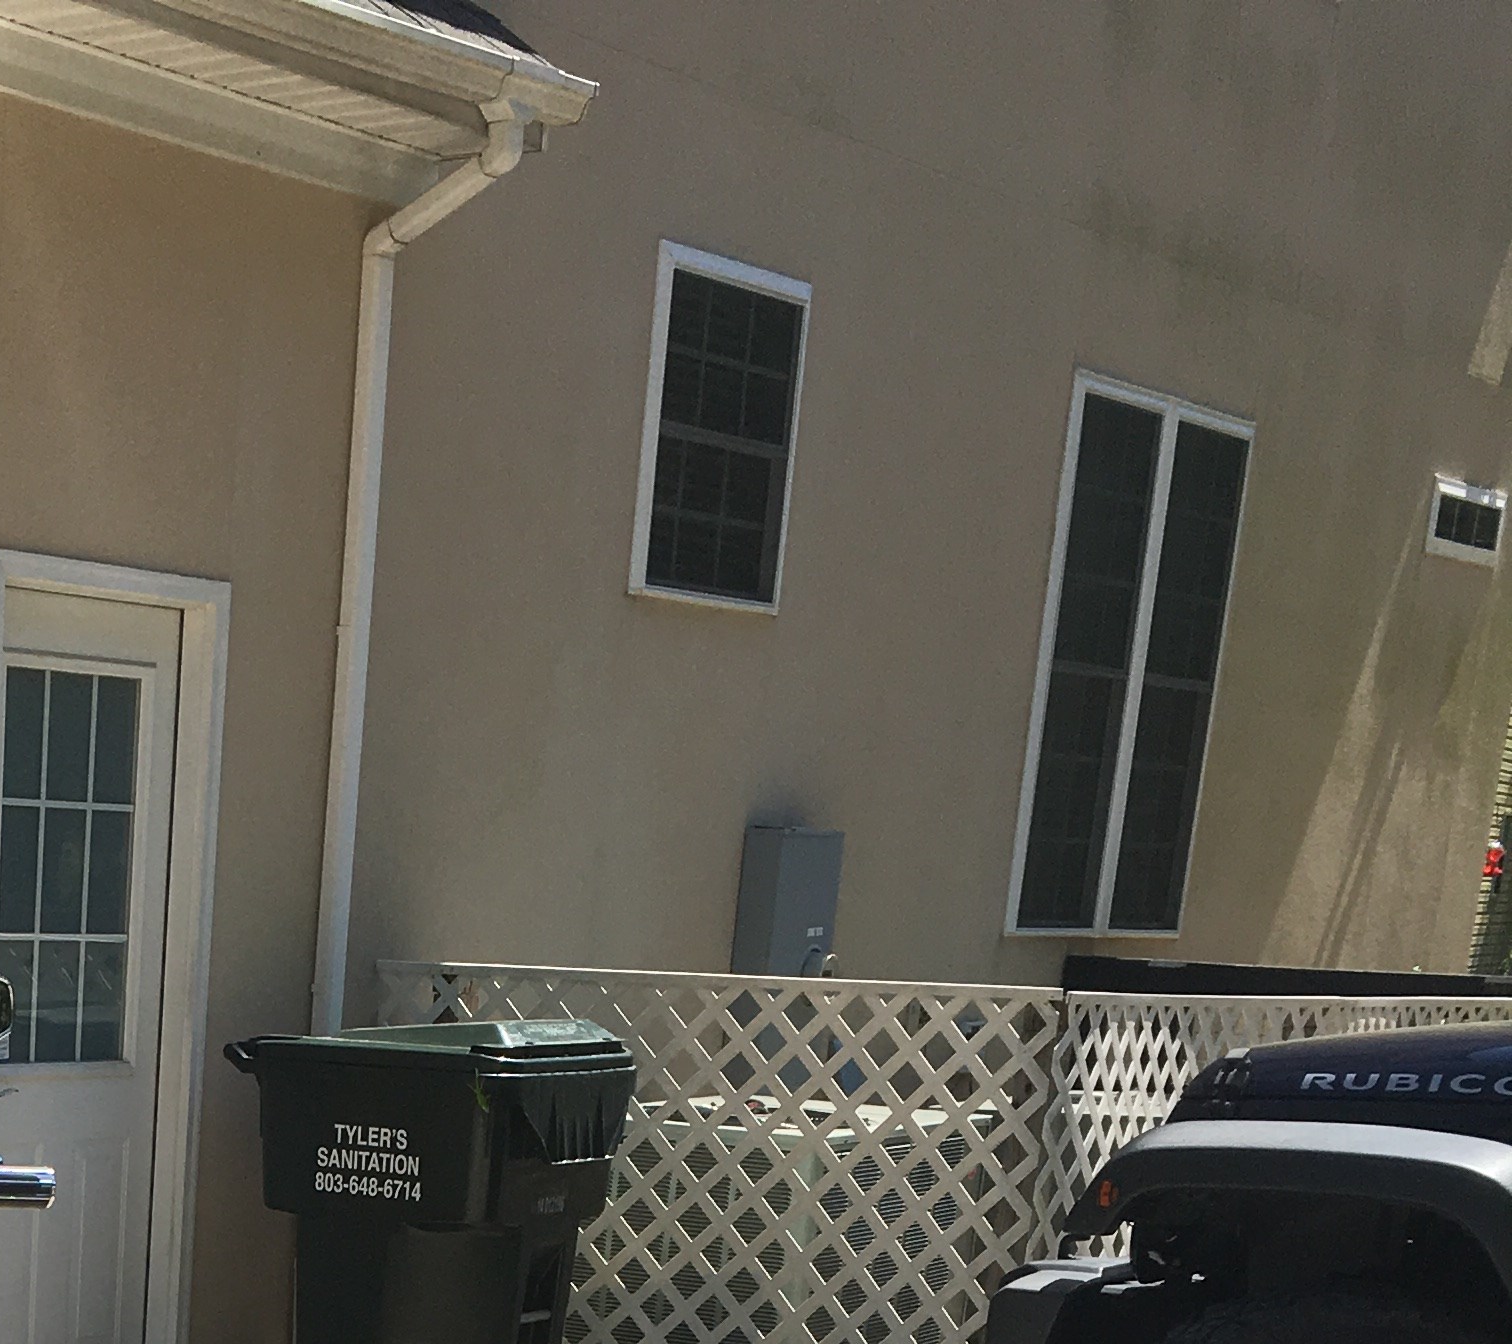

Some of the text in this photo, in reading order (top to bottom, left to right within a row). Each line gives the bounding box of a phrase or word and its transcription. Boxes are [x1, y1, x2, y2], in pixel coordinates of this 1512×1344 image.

[334, 1123, 408, 1150] TYLER'S
[317, 1146, 420, 1176] SANITATION
[315, 1171, 421, 1201] 803-648-6714
